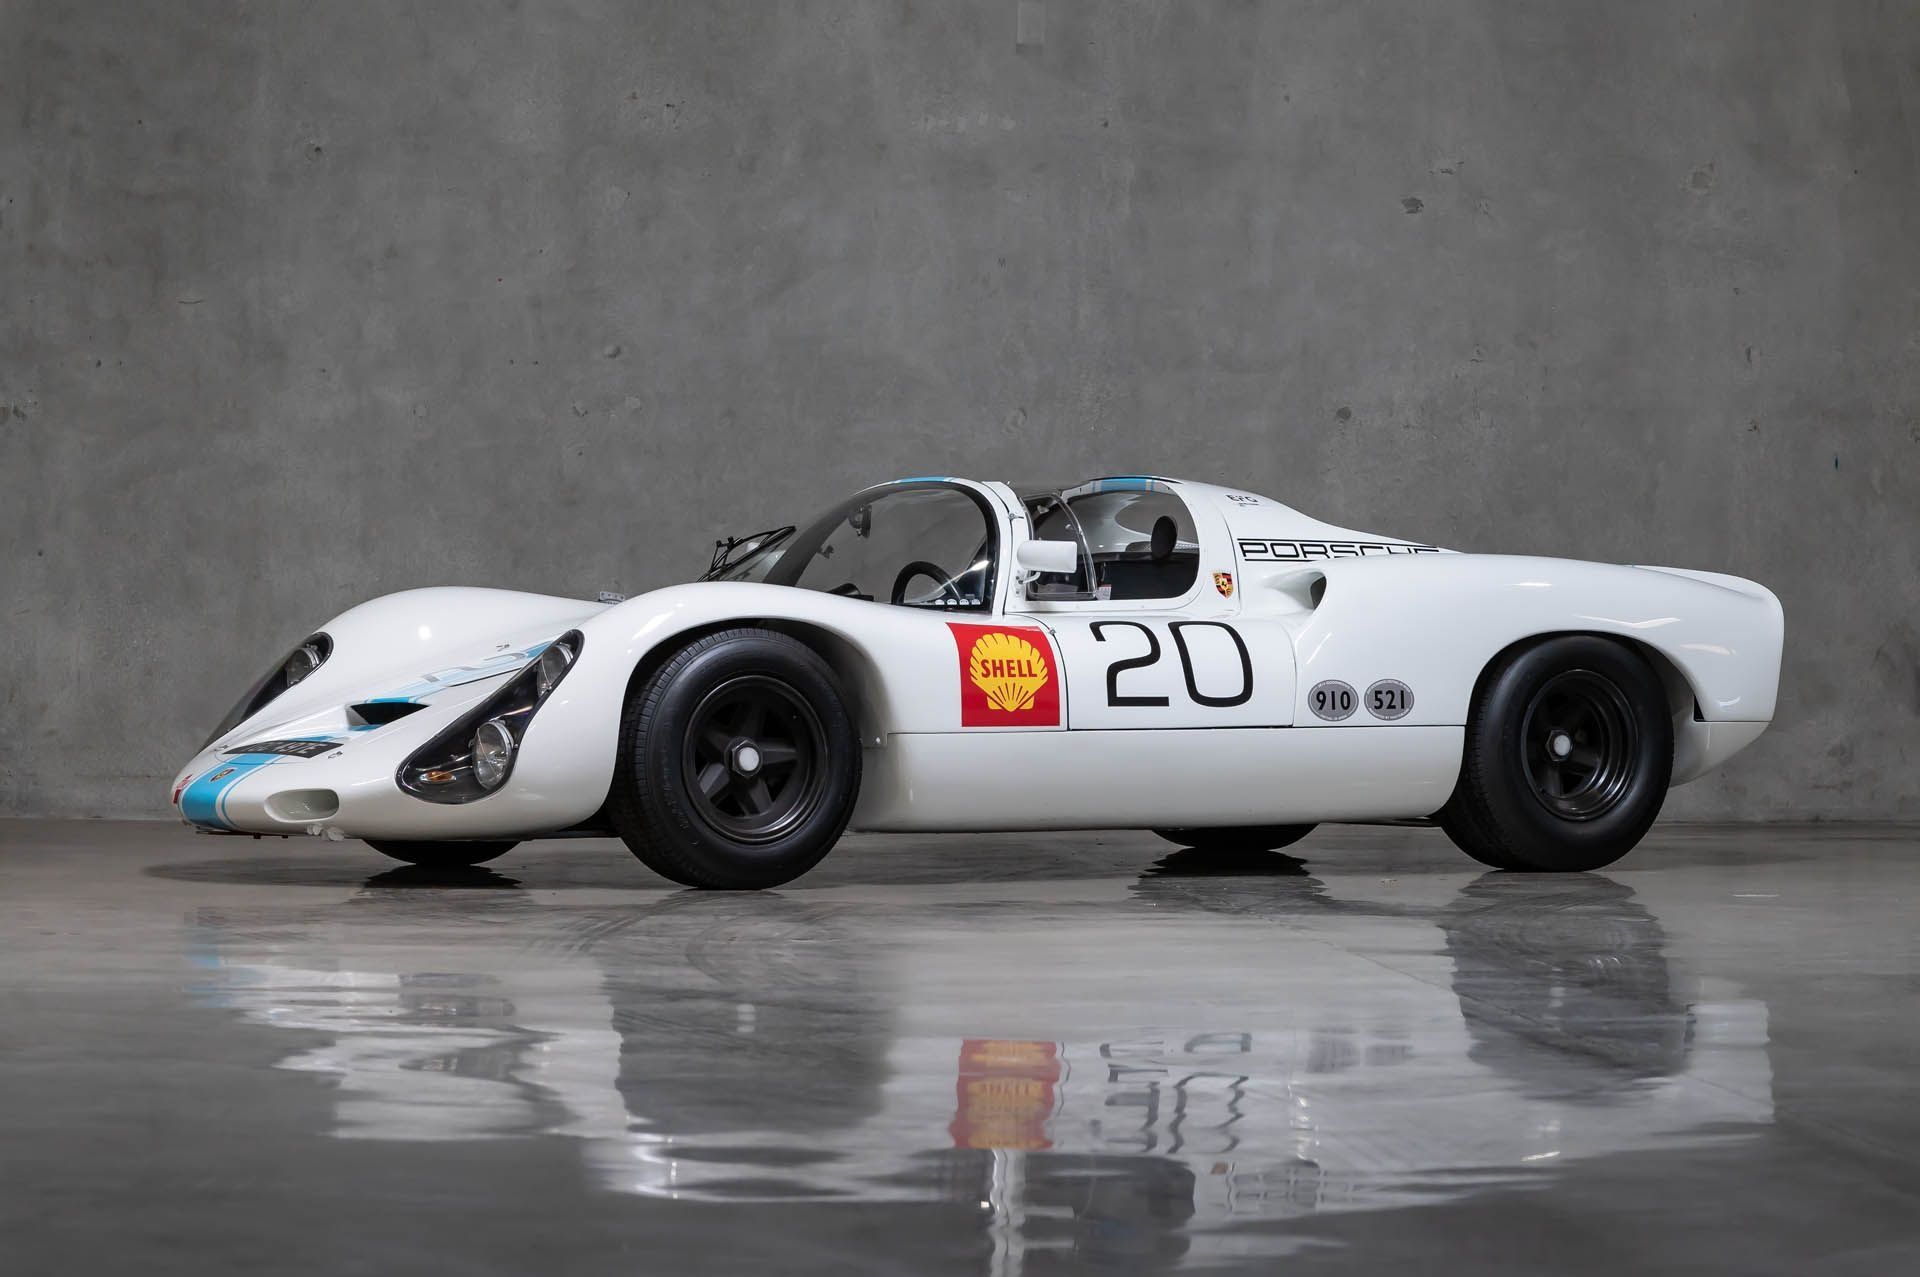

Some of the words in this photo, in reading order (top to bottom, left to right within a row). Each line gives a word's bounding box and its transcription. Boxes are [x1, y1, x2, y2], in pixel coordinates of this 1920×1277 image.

[980, 659, 1038, 678] SHELL
[1089, 621, 1254, 708] 20
[1316, 690, 1351, 711] 910
[1374, 690, 1405, 710] 521
